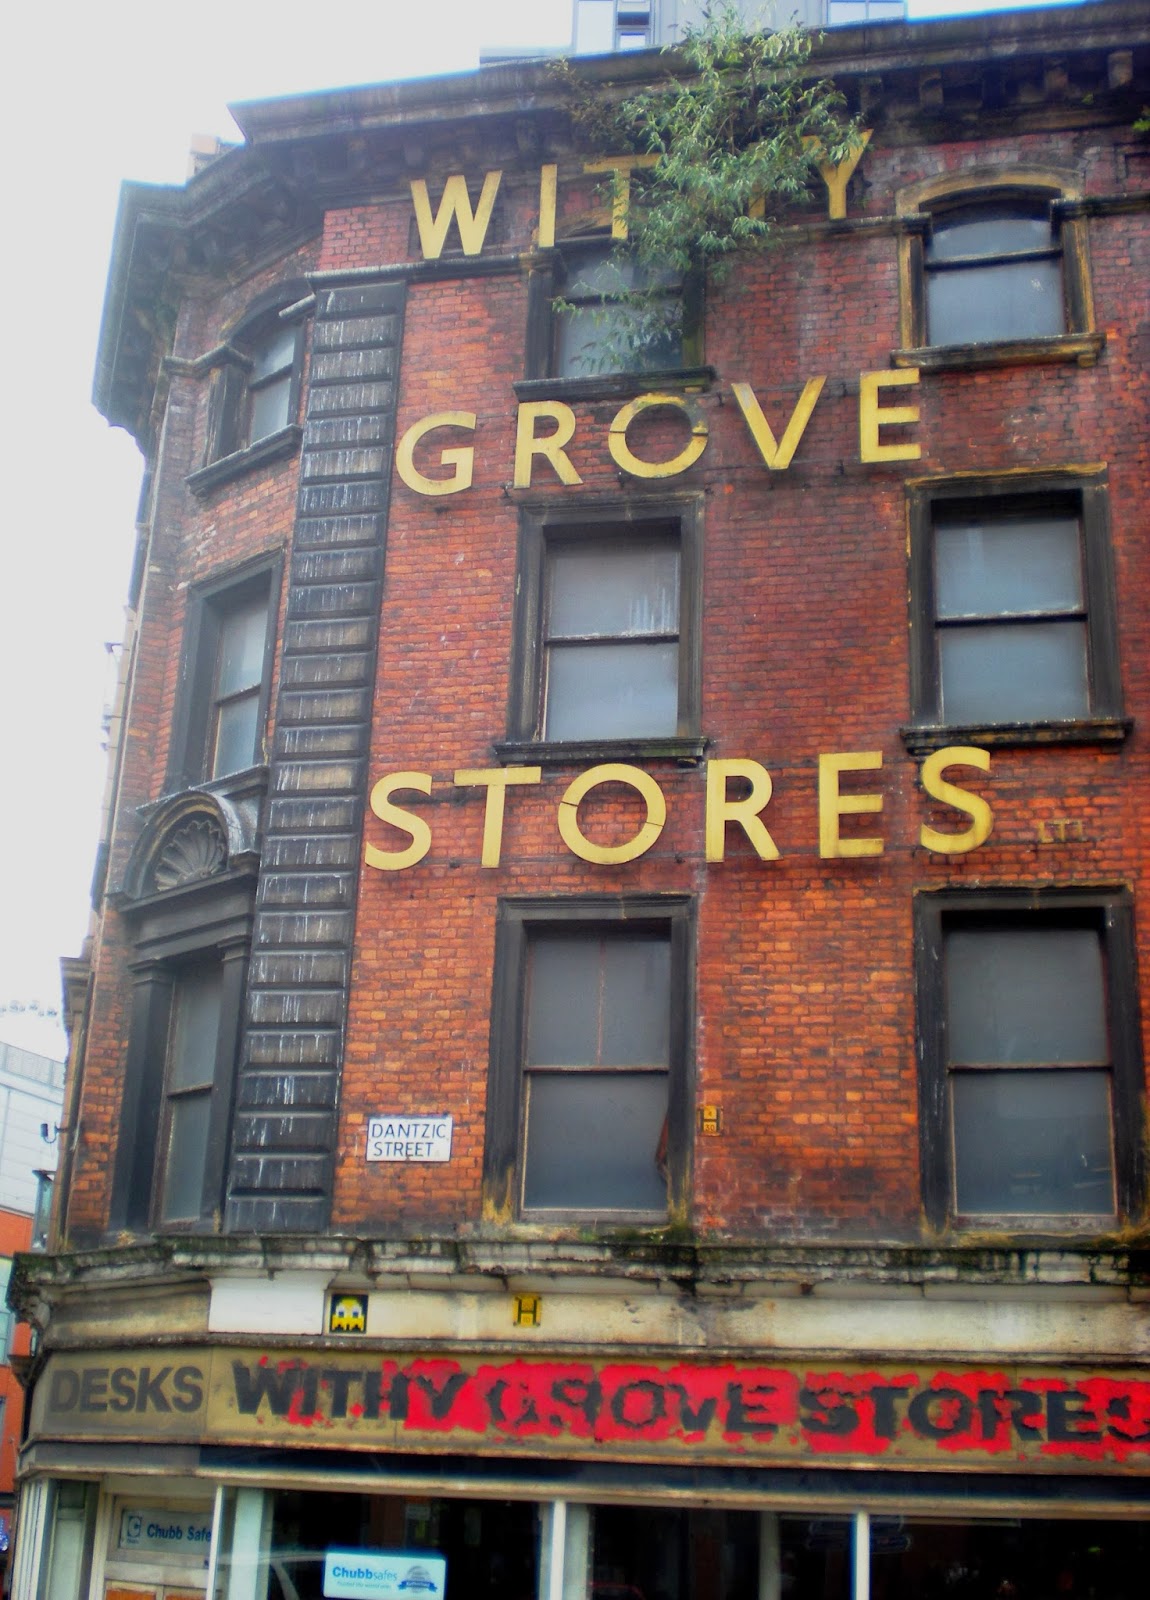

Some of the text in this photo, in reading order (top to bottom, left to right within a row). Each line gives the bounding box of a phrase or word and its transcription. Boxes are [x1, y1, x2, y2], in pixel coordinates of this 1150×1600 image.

[410, 129, 873, 260] WITY
[395, 367, 922, 496] GROVE
[364, 746, 994, 871] STORES
[372, 1123, 447, 1138] DANTZIC
[373, 1141, 434, 1157] STREET
[50, 1366, 204, 1413] DESKS
[232, 1359, 469, 1421] WITHY
[147, 1523, 183, 1540] Chubb
[332, 1566, 398, 1581] Chubbsafes
